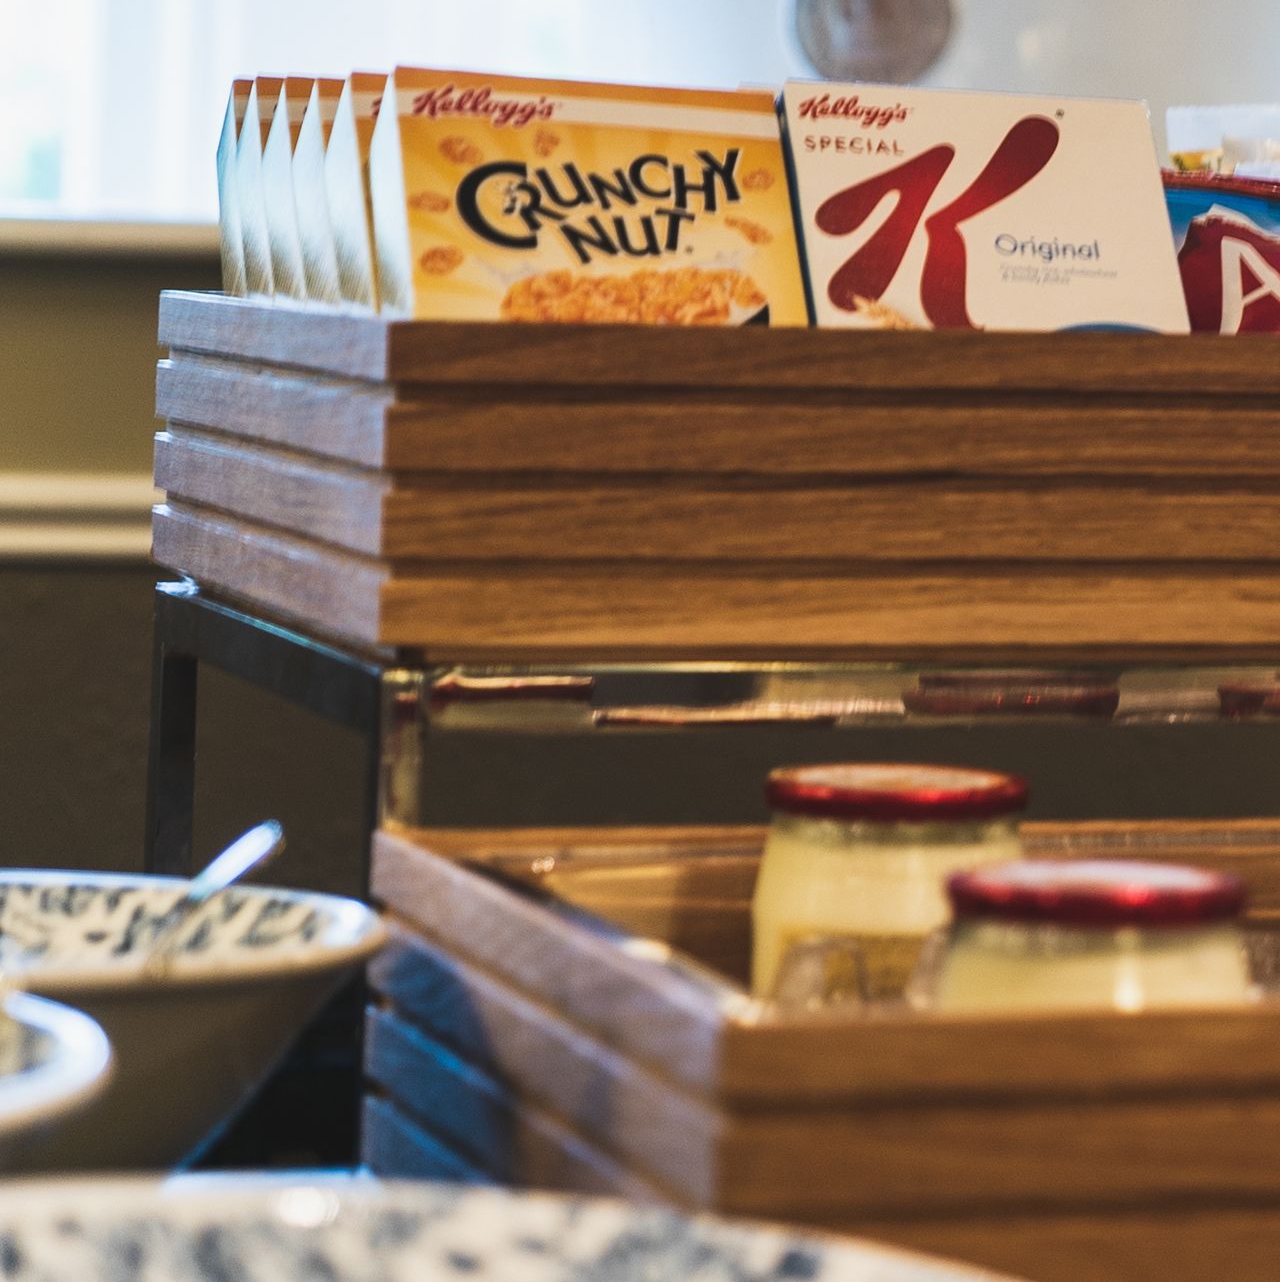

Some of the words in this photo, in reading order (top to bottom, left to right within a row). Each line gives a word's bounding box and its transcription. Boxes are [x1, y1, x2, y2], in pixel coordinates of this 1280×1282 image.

[412, 83, 555, 129] Kellogg's
[799, 93, 908, 130] Kellogg's
[804, 134, 904, 156] SPECIAL
[560, 208, 696, 264] NUT
[815, 114, 1060, 331] K
[994, 233, 1101, 263] Original
